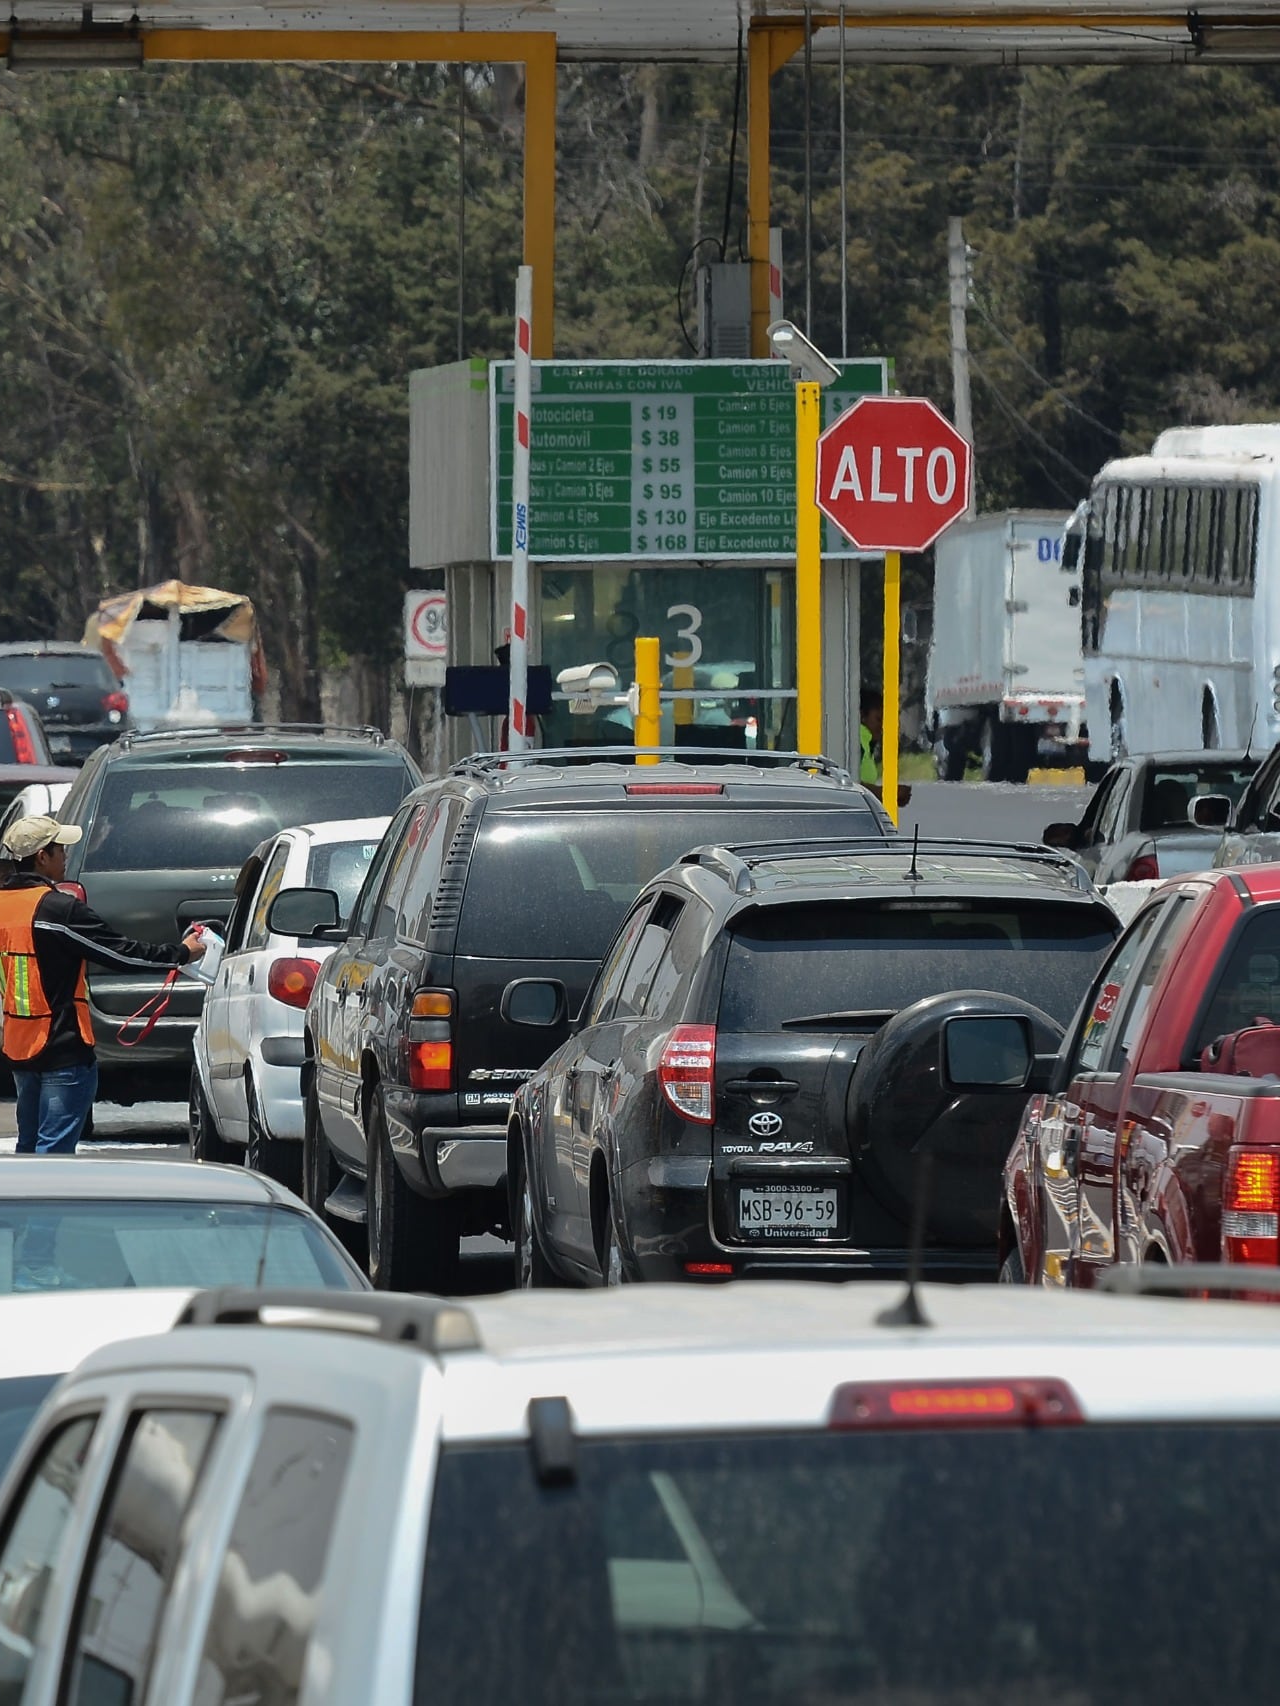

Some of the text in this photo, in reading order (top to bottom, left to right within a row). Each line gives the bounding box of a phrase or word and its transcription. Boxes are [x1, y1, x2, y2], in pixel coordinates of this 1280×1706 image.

[568, 379, 683, 391] TARIFAS CON IVA
[746, 379, 795, 391] VEHIC
[641, 406, 651, 421] $
[657, 406, 677, 421] 19
[769, 398, 791, 414] Ejes
[769, 419, 791, 437] Ejes
[641, 430, 651, 446] $
[658, 430, 679, 446] 38
[770, 444, 792, 461] Ejes
[589, 458, 595, 471] 2
[596, 458, 615, 476] Ejes
[642, 458, 652, 473] $
[659, 458, 681, 473] 55
[761, 465, 767, 479] 9
[770, 465, 793, 482] Ejes
[829, 445, 957, 505] ALTO
[588, 483, 594, 498] 3
[596, 483, 615, 501] Ejes
[643, 484, 653, 500] $
[660, 484, 682, 500] 95
[761, 488, 773, 503] 10
[577, 509, 599, 529] Ejes
[637, 510, 647, 526] $
[655, 510, 687, 525] 130
[699, 512, 717, 529] Eje
[720, 511, 781, 526] Excedente
[569, 535, 575, 548] 5
[637, 535, 648, 551] $
[655, 535, 687, 551] 168
[698, 536, 716, 552] Eje
[718, 535, 780, 550] Excedente
[664, 603, 703, 668] 3
[759, 1142, 814, 1153] RAV4
[741, 1200, 835, 1221] MSB-96-59
[764, 1229, 829, 1238] Universidad
